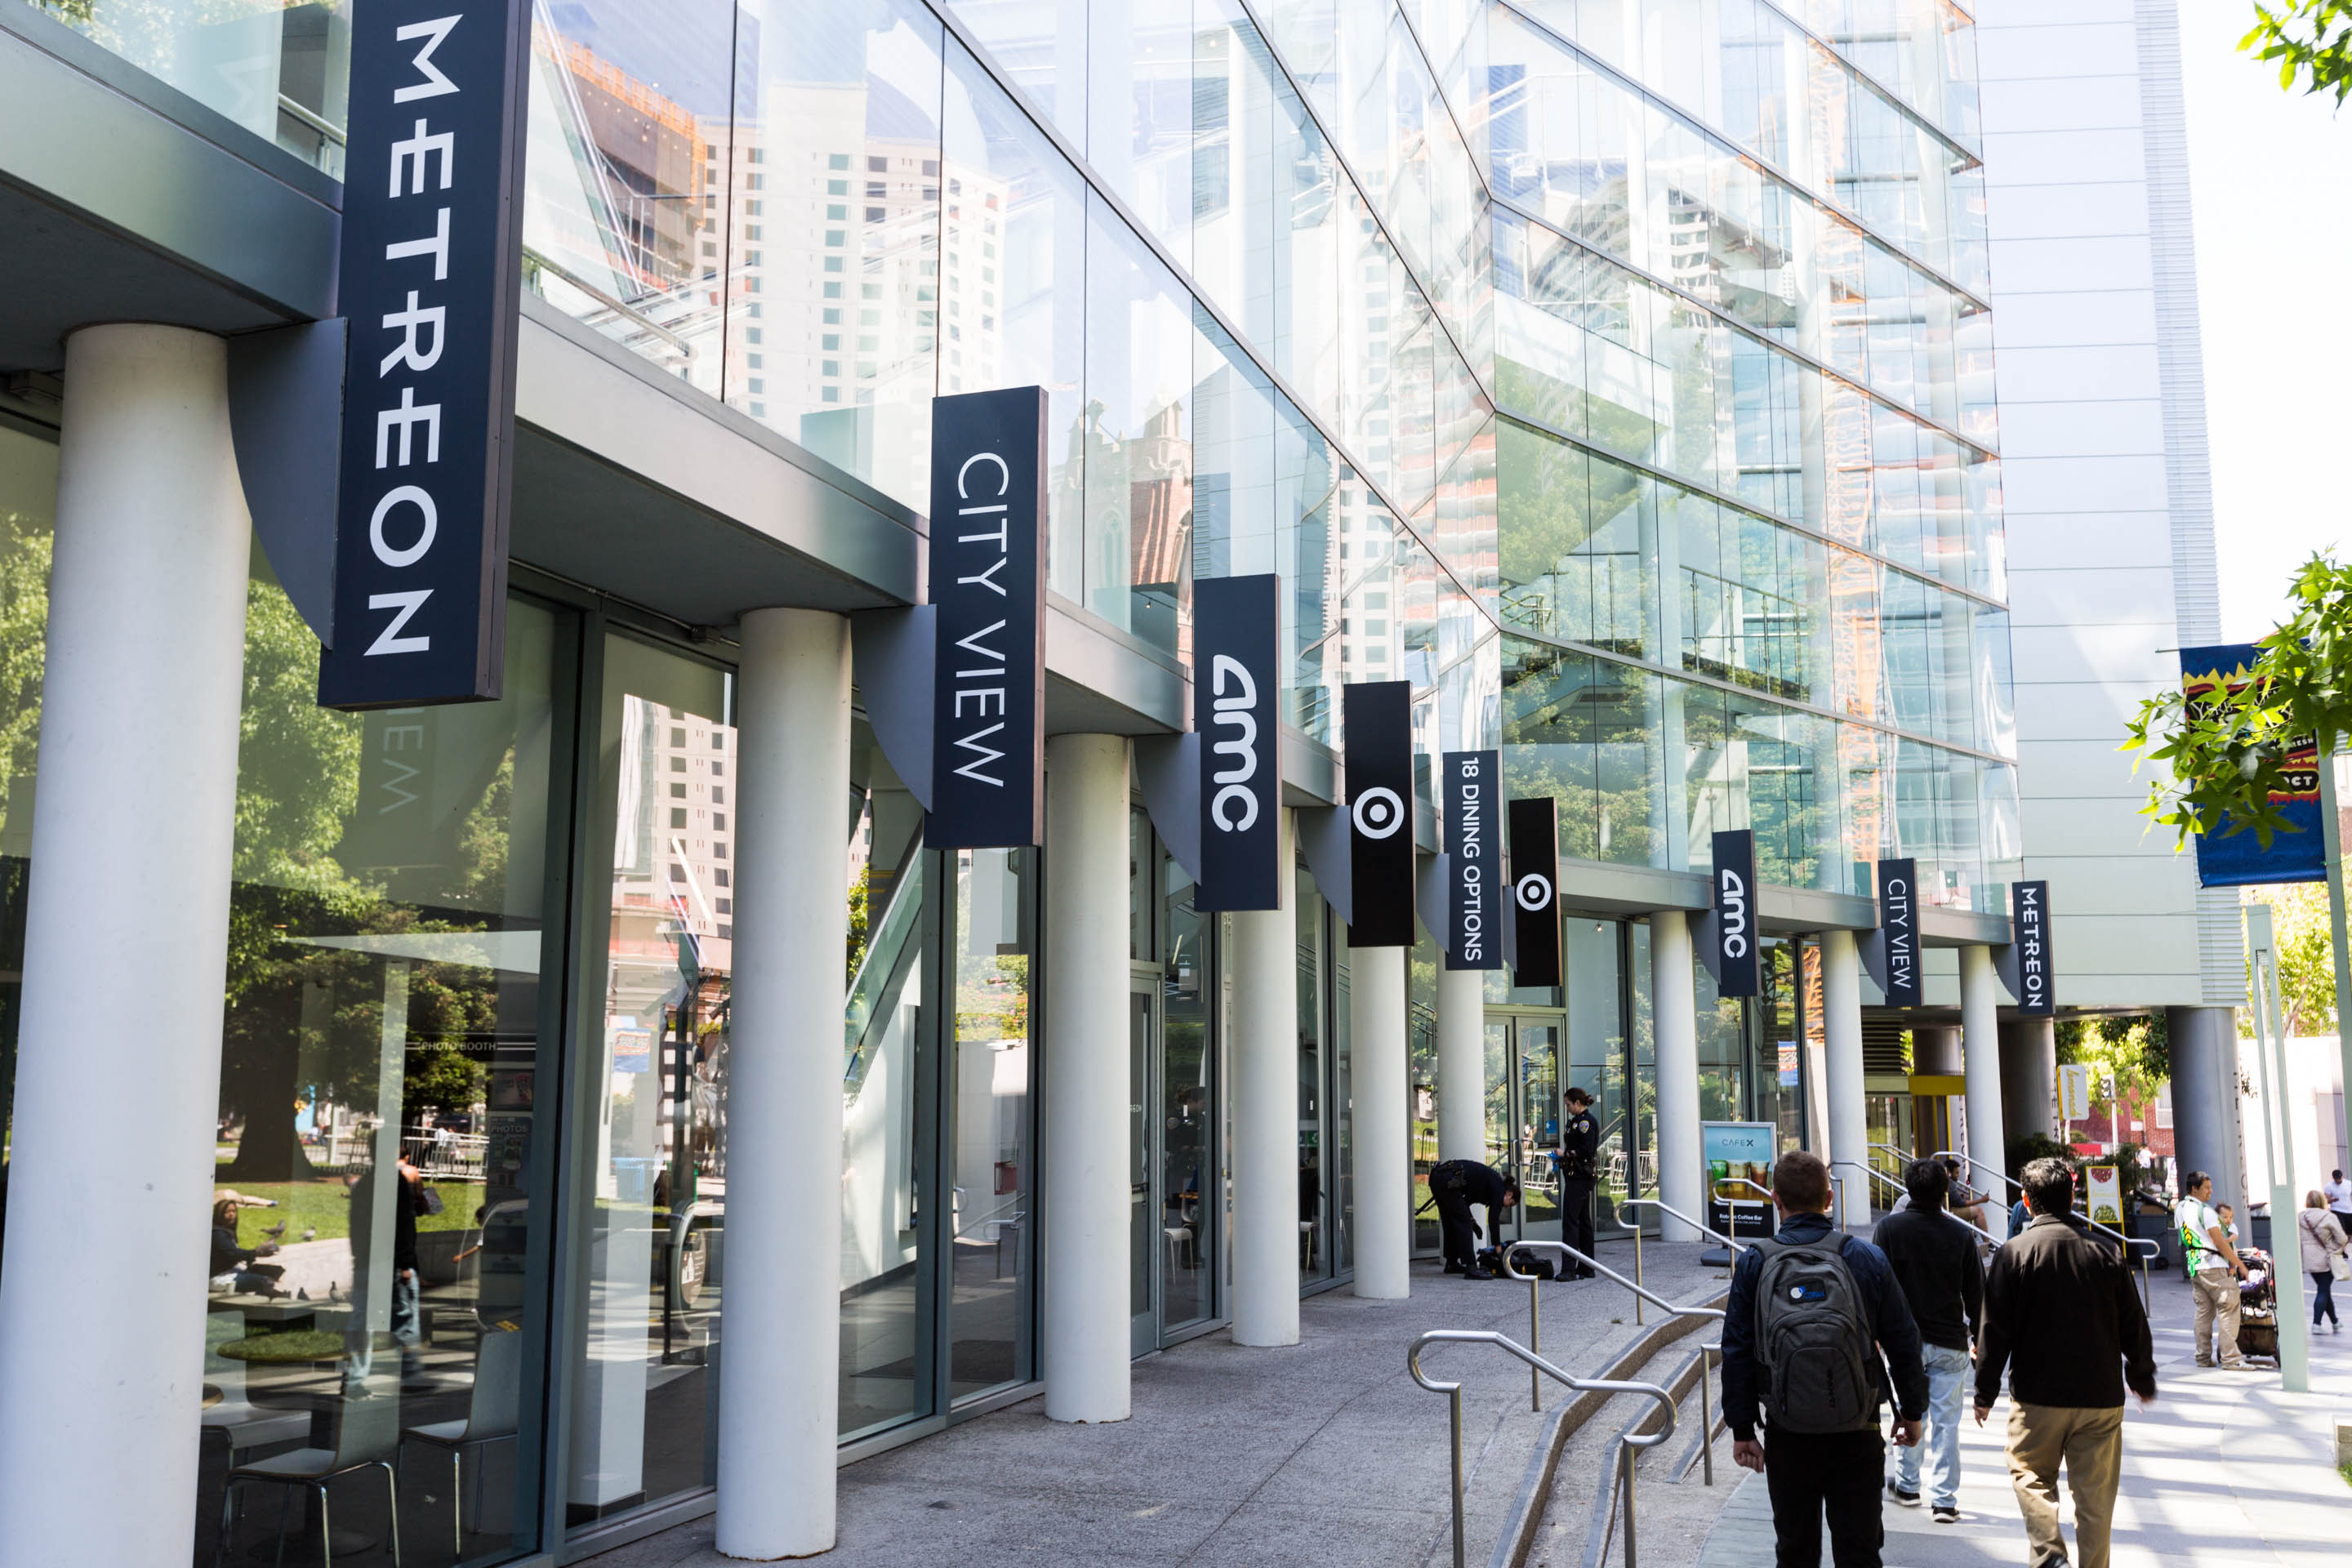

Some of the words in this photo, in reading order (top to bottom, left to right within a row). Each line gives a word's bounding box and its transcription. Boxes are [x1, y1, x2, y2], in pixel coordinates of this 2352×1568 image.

[364, 14, 463, 656] METREON
[957, 452, 1009, 596] CITY
[953, 619, 1005, 786] VIEW
[1462, 757, 1478, 778] 18
[1462, 785, 1481, 858] DINING
[1463, 866, 1482, 962] OPTIONS
[1887, 879, 1909, 927] CITY
[1891, 933, 1912, 988] VIEW
[2021, 889, 2043, 1007] METREON
[422, 1041, 457, 1051] PHOTO
[460, 1041, 497, 1051] BOOTH
